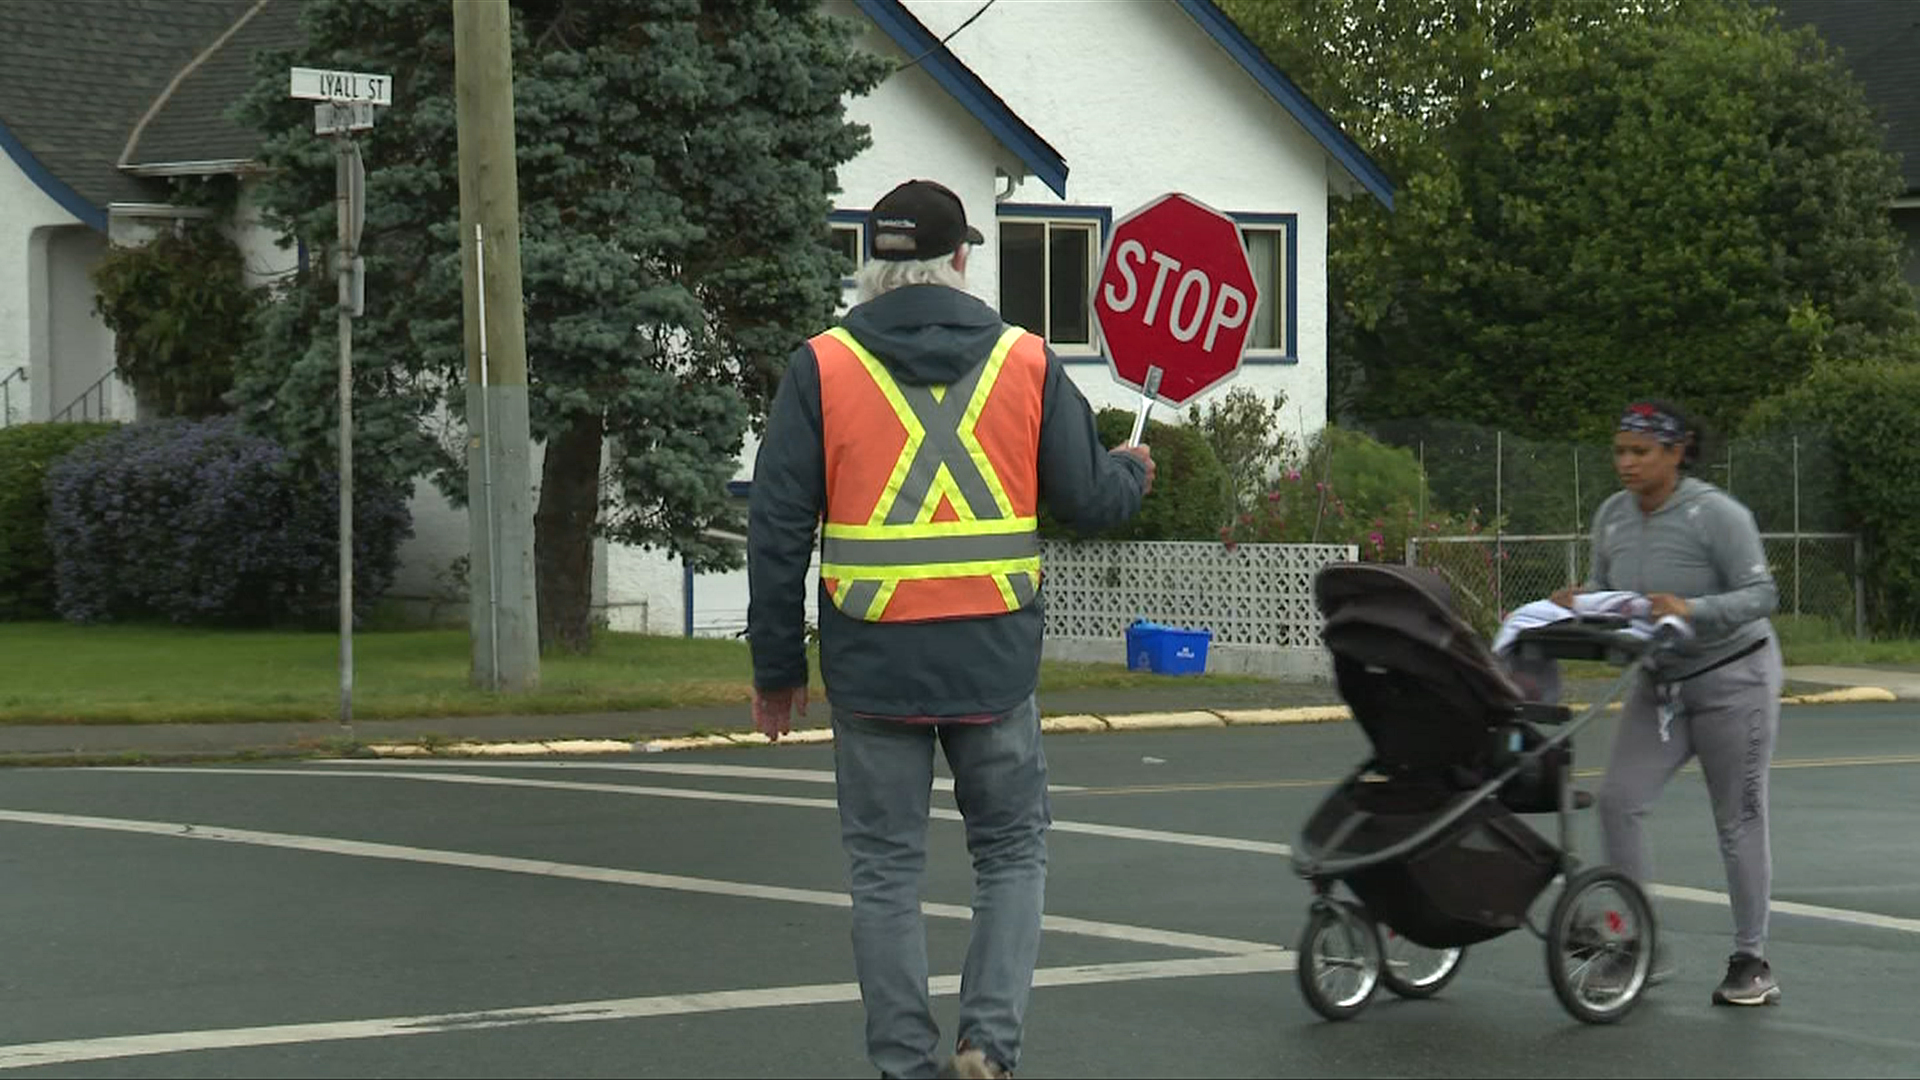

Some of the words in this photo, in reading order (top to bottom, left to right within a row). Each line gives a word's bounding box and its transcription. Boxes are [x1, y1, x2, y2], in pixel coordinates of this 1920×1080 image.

[320, 74, 359, 98] LYALL
[368, 78, 384, 100] ST
[1104, 239, 1248, 352] STOP
